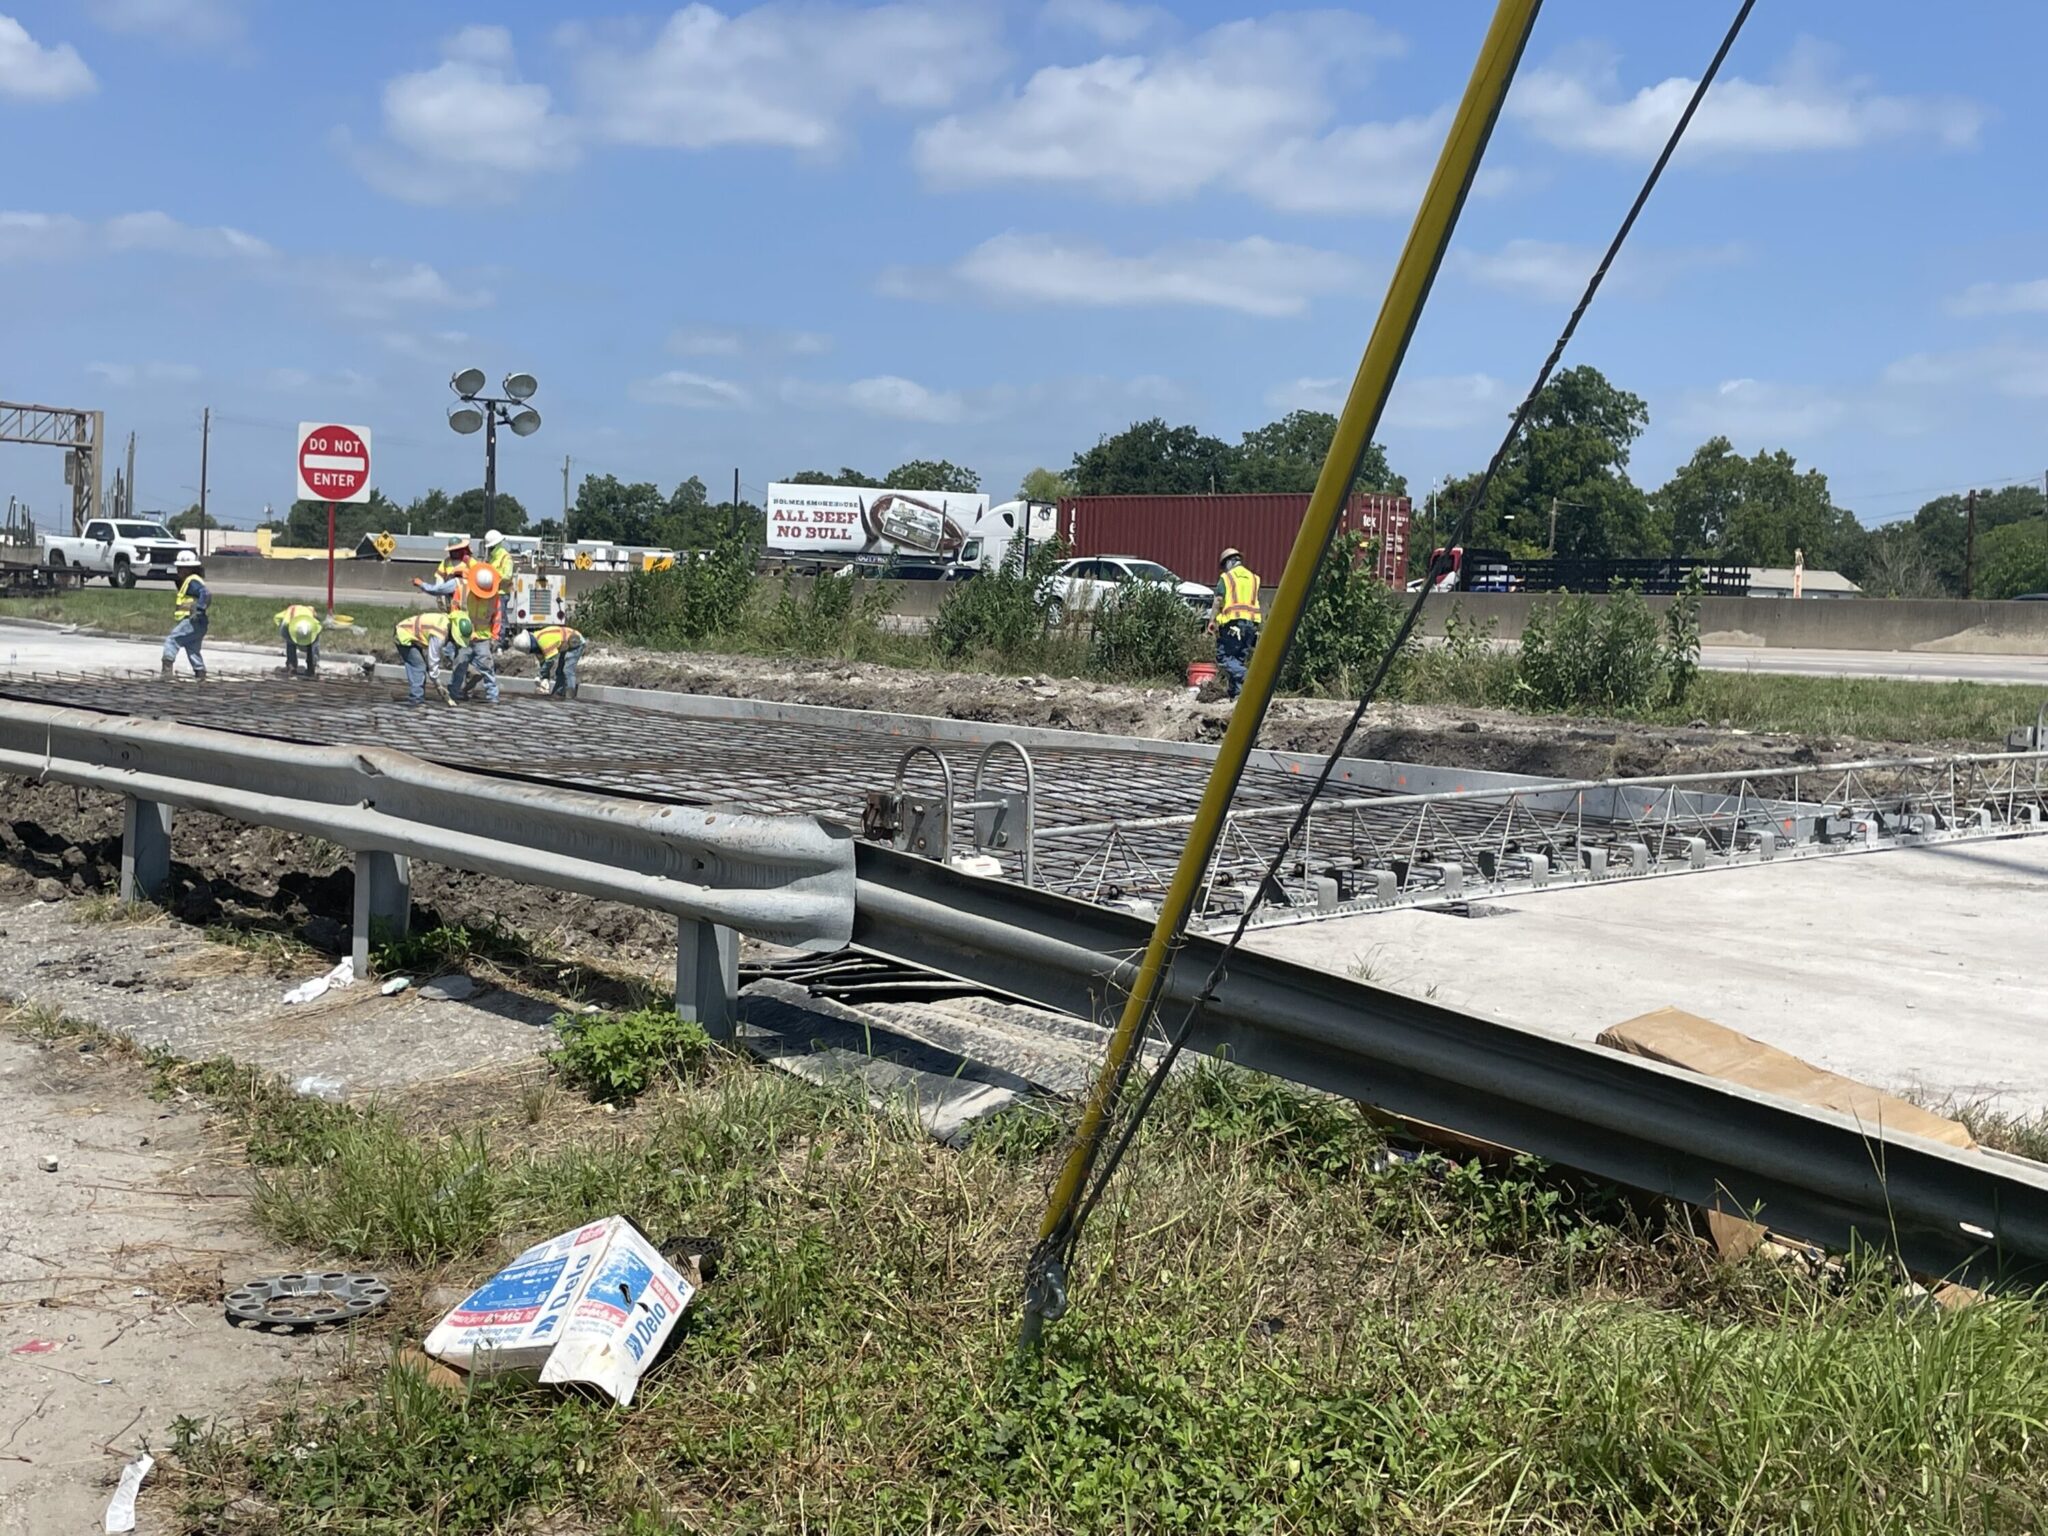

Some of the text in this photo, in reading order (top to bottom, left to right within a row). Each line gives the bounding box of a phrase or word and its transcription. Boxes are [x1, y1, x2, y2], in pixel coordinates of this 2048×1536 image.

[309, 438, 361, 454] DO NOT
[313, 472, 355, 488] ENTER
[773, 498, 859, 508] HOLMES SMOKEHOUSE
[772, 509, 858, 525] ALL BEEF
[1362, 513, 1377, 528] tex
[776, 525, 852, 541] NO BULL
[548, 1254, 591, 1312] Delo
[635, 1302, 667, 1346] Delo
